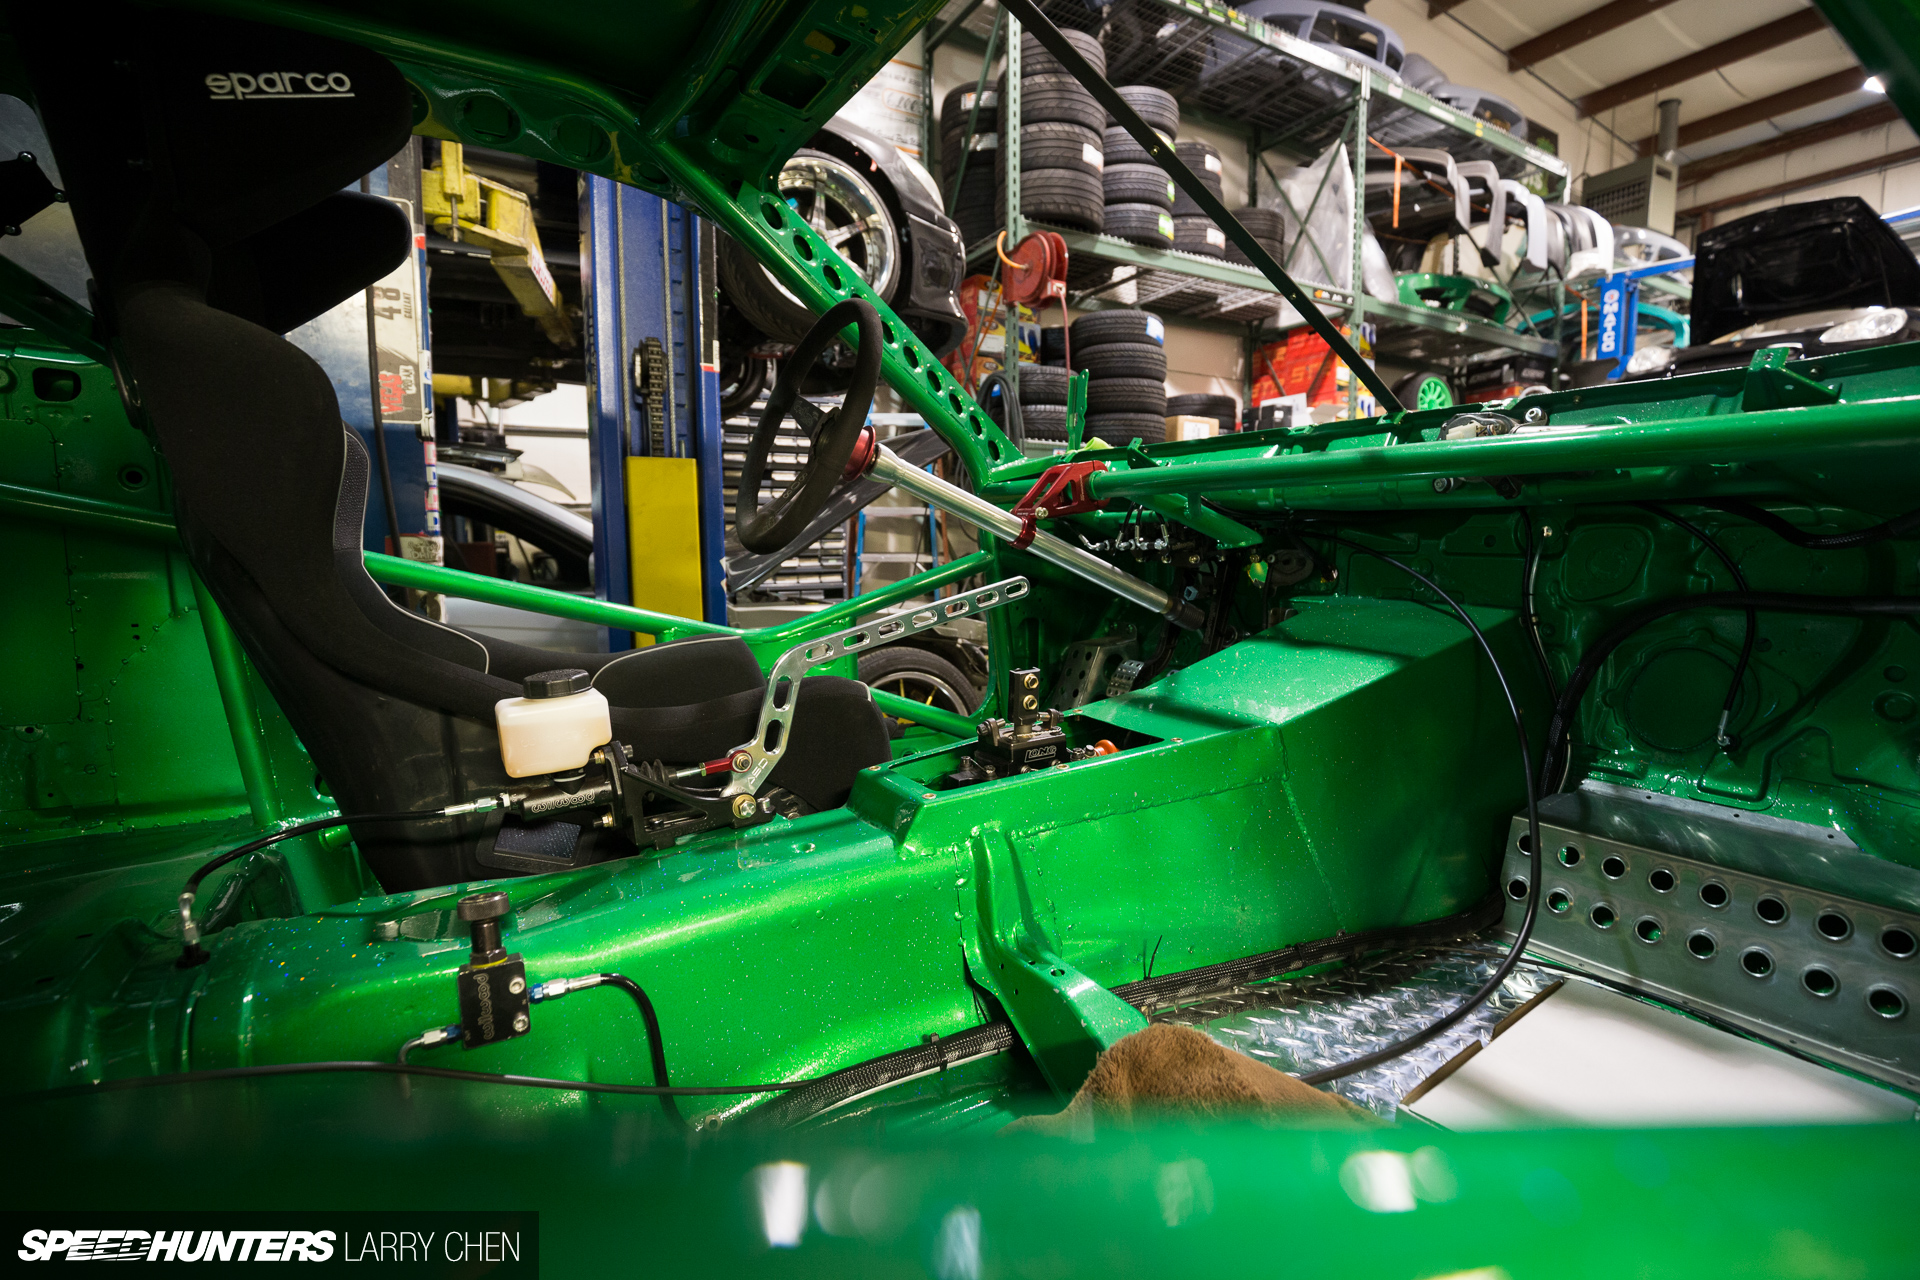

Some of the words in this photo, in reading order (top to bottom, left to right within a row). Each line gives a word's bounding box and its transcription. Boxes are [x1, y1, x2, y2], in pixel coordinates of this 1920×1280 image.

[205, 72, 353, 99] sparco
[1601, 302, 1619, 352] MATCO
[379, 372, 405, 414] VEGAS
[1024, 745, 1057, 762] LONG
[747, 758, 768, 790] ASD
[531, 789, 595, 813] wilwood
[473, 972, 495, 1040] wilwood
